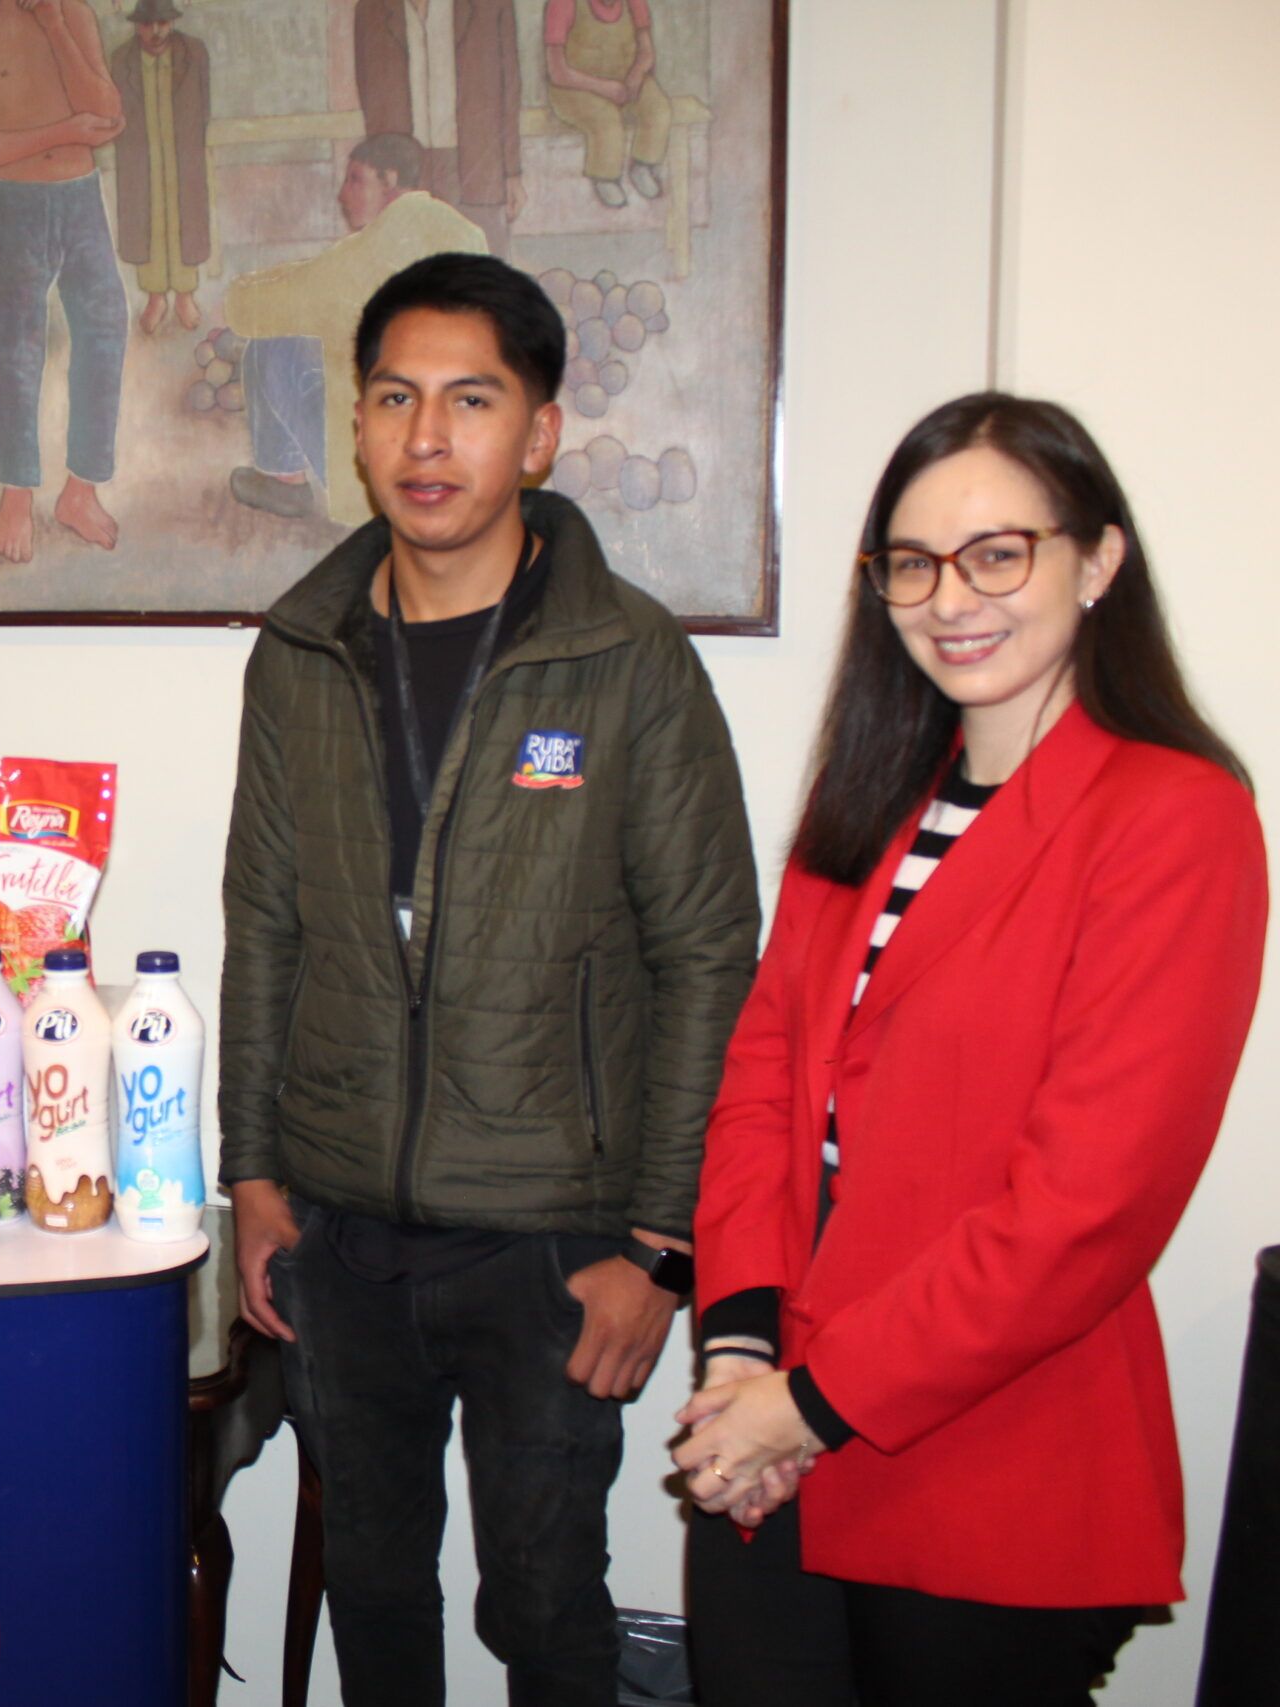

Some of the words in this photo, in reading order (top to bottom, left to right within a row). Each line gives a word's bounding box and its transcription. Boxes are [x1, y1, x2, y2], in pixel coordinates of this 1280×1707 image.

[526, 733, 577, 757] PURA
[531, 751, 576, 773] VIDA
[9, 804, 67, 838] Reyna
[36, 1010, 72, 1041] Pil
[133, 1012, 169, 1043] Pil
[38, 1086, 90, 1142] gurt
[132, 1087, 186, 1146] gurt
